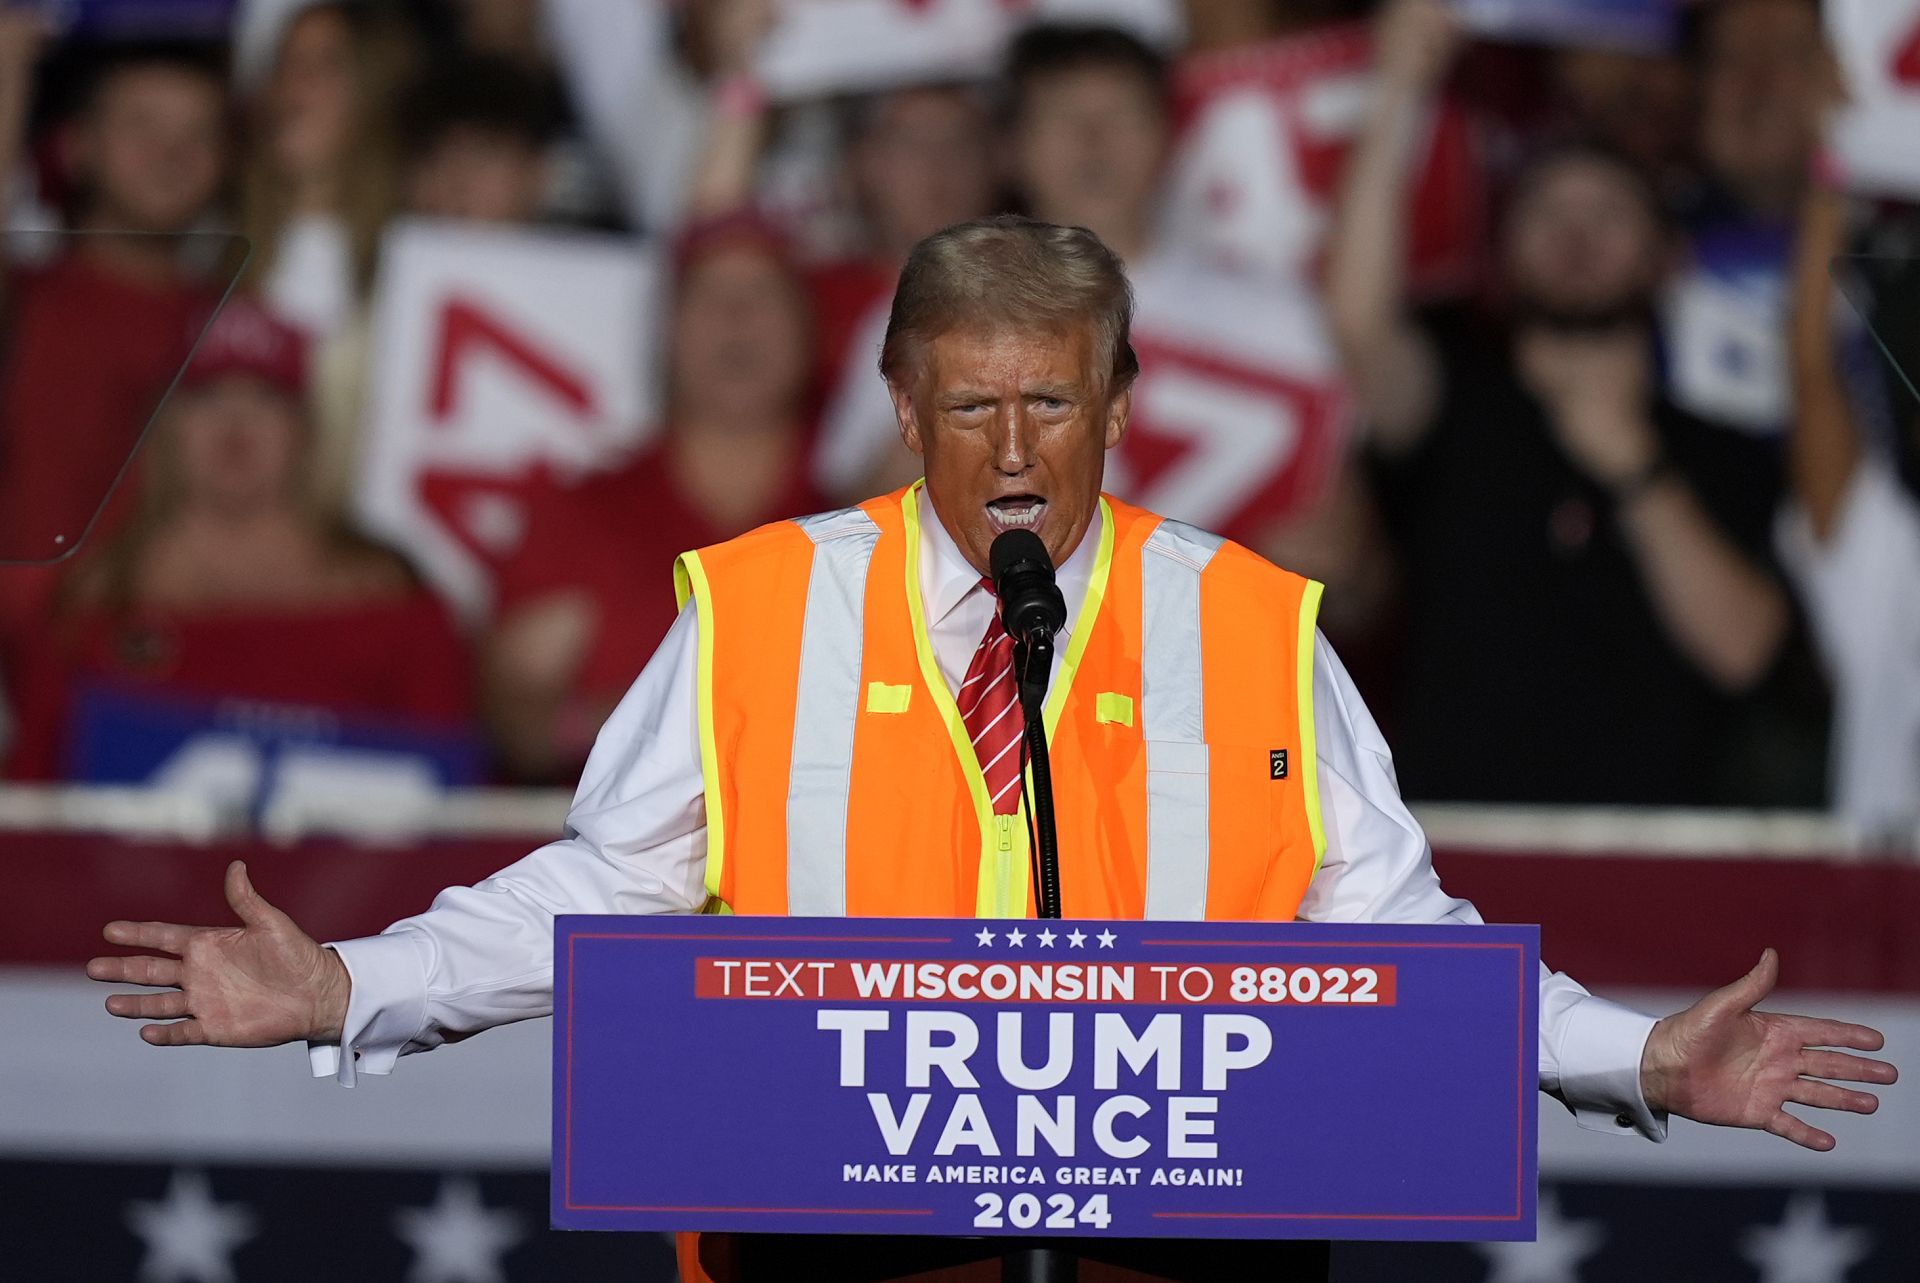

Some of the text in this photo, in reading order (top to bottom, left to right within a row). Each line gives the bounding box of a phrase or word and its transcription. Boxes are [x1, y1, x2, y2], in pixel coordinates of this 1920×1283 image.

[1273, 759, 1285, 777] 2
[713, 961, 1378, 1003] TEXT WISCONSIN TO 88022
[817, 1009, 1274, 1091] TRUMP
[867, 1093, 1218, 1159] VANCE
[843, 1164, 1243, 1186] MAKE AMERICA GREAT AGAIN!
[973, 1192, 1112, 1229] 2024
